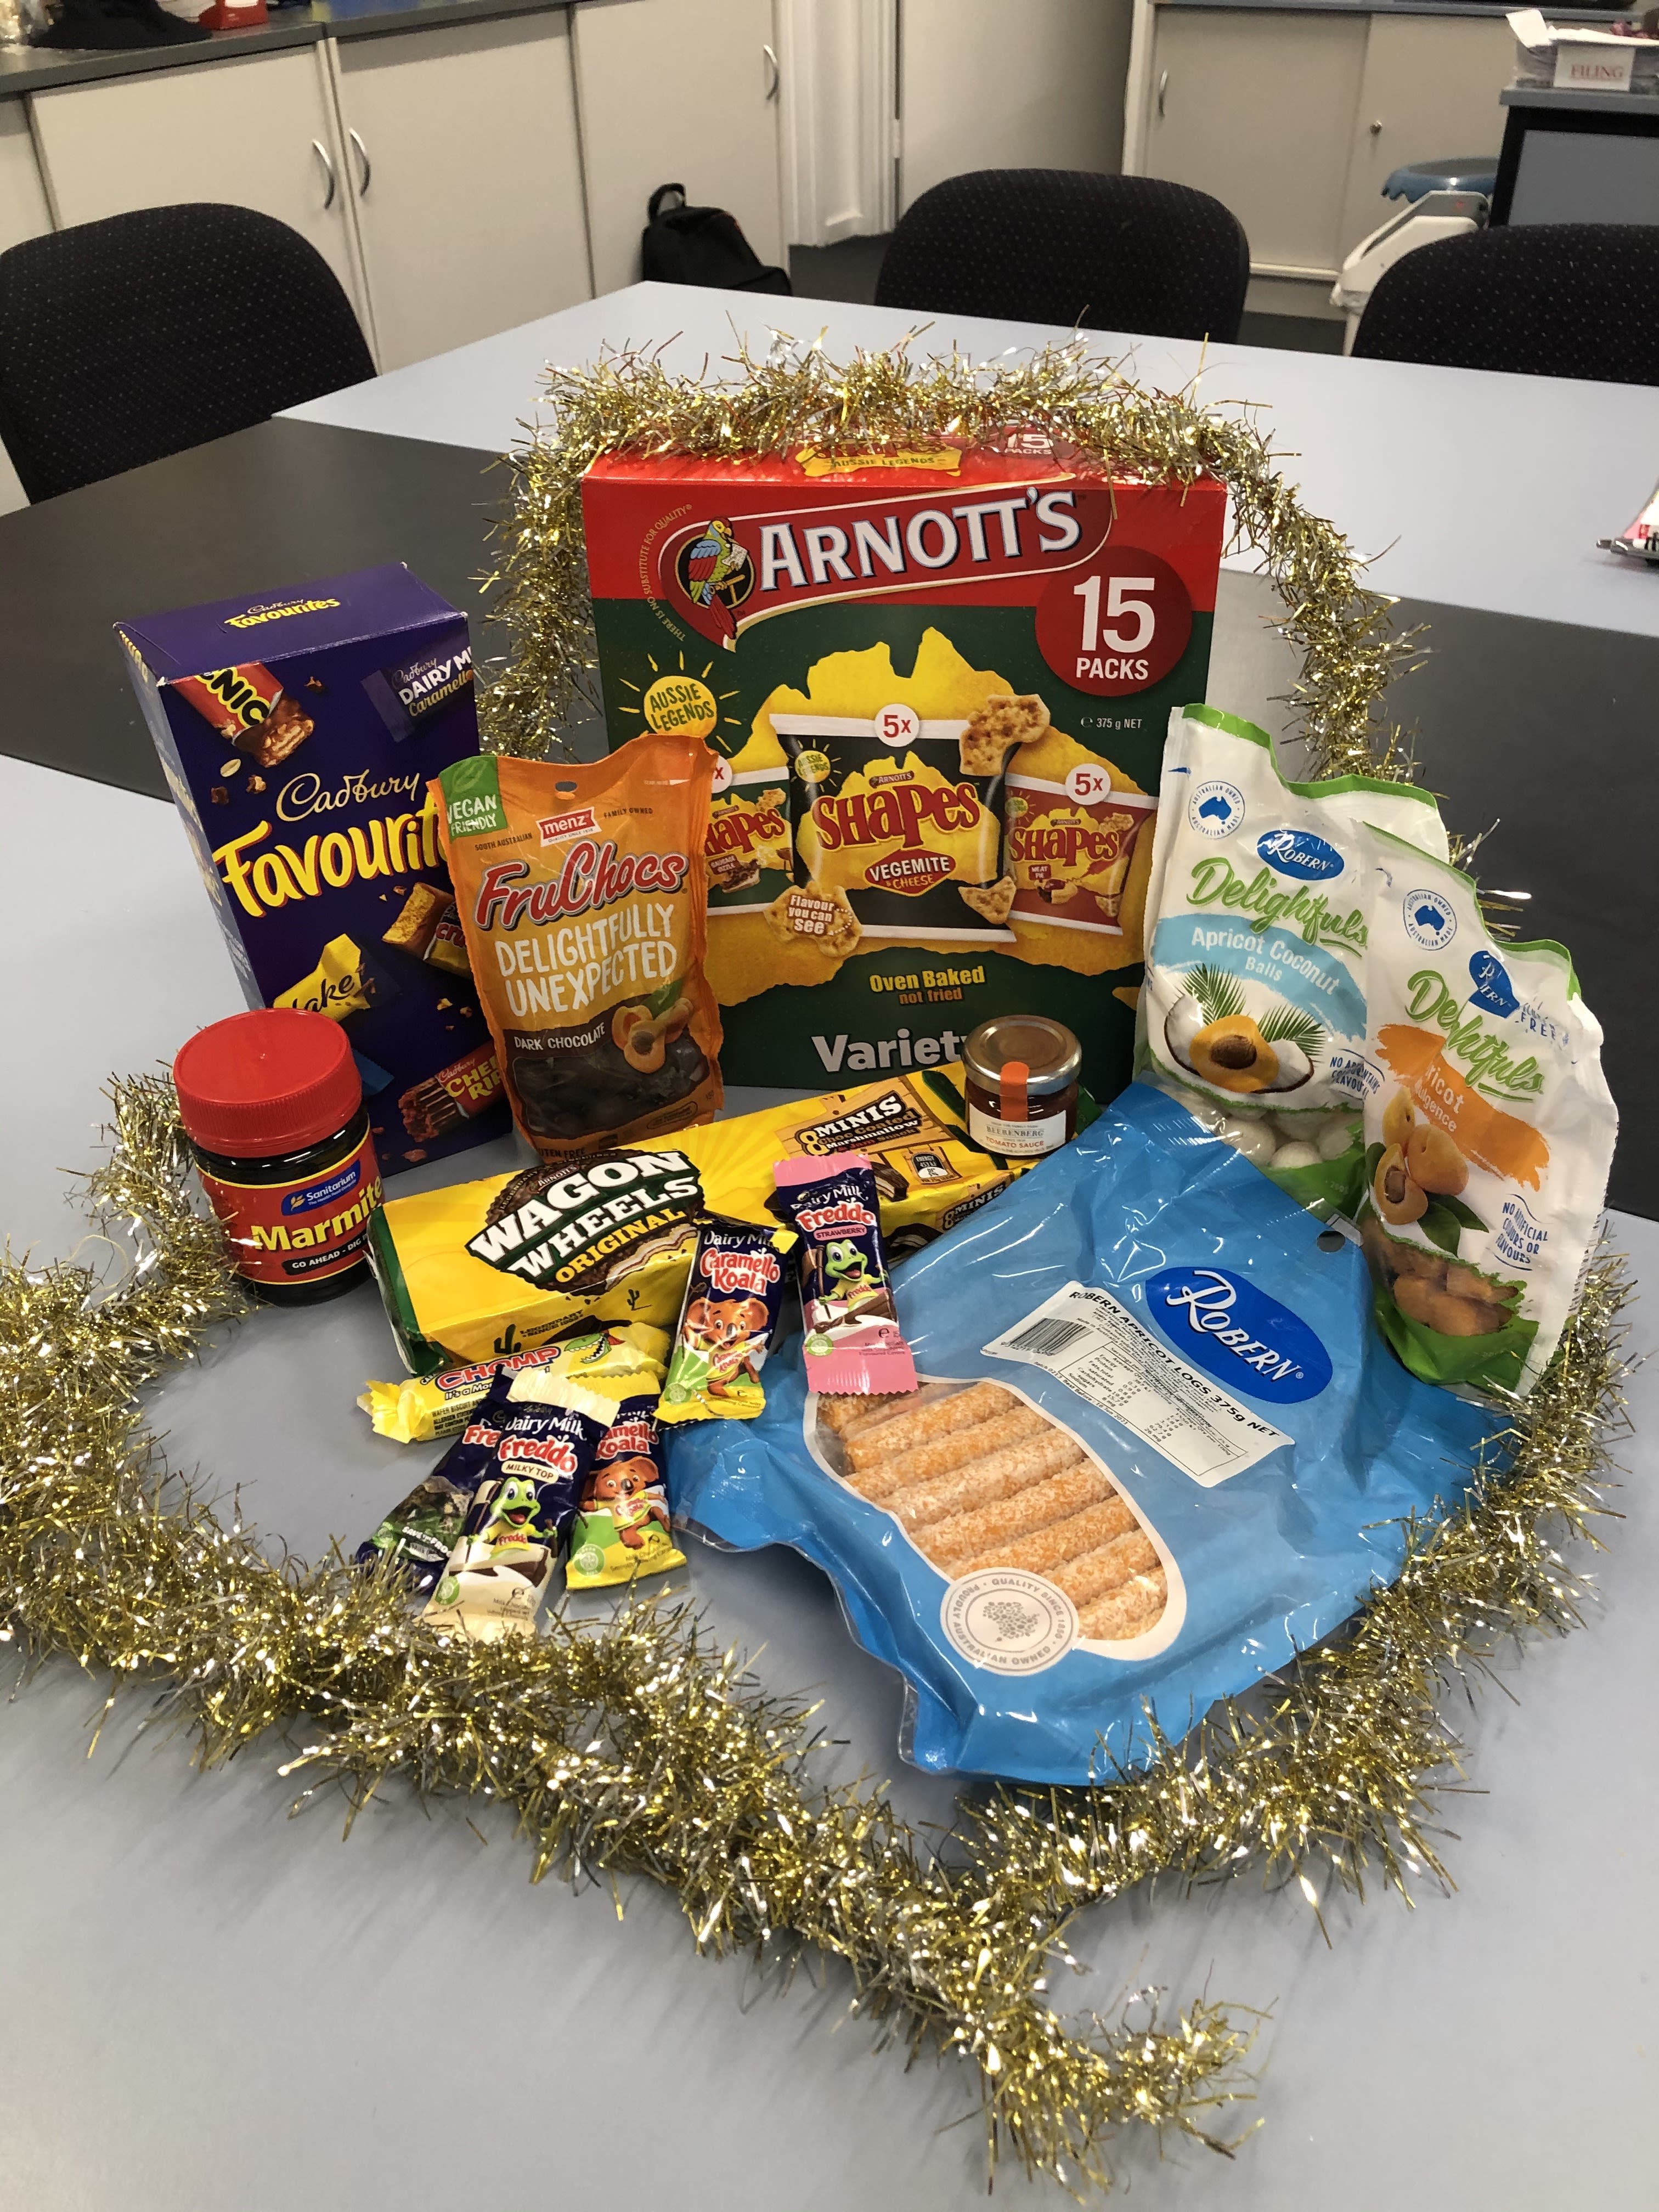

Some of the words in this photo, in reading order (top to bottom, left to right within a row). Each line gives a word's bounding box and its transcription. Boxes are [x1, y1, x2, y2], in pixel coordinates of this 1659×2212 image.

[1571, 65, 1623, 78] FILING
[1008, 433, 1053, 449] 15
[834, 459, 874, 467] AUSSIE
[882, 457, 934, 466] LEGENDS
[644, 528, 658, 545] FOR
[760, 486, 1082, 591] ARNOTT'S
[639, 545, 653, 595] SUBSTITUTE
[224, 596, 341, 629] Favourites
[246, 598, 304, 615] Cadbury
[647, 596, 659, 611] NO
[655, 610, 665, 619] IS
[1074, 575, 1155, 653] 15
[662, 618, 686, 641] THERE
[391, 658, 437, 689] Cadbury
[1076, 658, 1149, 680] PACKS
[398, 659, 452, 705] DAIRY
[650, 684, 701, 713] AUSSIE
[651, 701, 714, 731] LEGENDS
[882, 714, 911, 738] 5x
[1096, 717, 1113, 729] 375
[1124, 718, 1143, 730] NET
[276, 769, 420, 822] Cadbury
[1075, 772, 1103, 795] 5x
[1192, 785, 1223, 804] AUSTRALIAN
[1225, 788, 1240, 804] OWNED
[447, 794, 497, 823] VEGAN
[603, 809, 627, 819] FAMILY
[450, 813, 498, 836] FRIENDLY
[544, 814, 588, 835] menz
[1192, 817, 1225, 836] AUSTRALIAN
[1227, 815, 1239, 830] MADE
[475, 840, 496, 851] SOUTH
[497, 832, 532, 847] AUSTRALIAN
[869, 857, 951, 882] VEGEMITE
[893, 874, 934, 889] CHEESE
[474, 840, 687, 929] FruChocs
[790, 895, 834, 911] Flavour
[1186, 857, 1368, 947] Delightfuls
[1434, 898, 1451, 916] OWNED
[788, 907, 809, 918] you
[811, 911, 832, 922] can
[794, 918, 825, 934] see
[495, 903, 674, 977] DELIGHTFULLY
[1408, 924, 1438, 946] AUSTRALIAN
[1440, 927, 1453, 943] MADE
[1191, 927, 1265, 955] Apricot
[1269, 940, 1340, 996] Coconut
[1245, 957, 1283, 983] Balls
[505, 941, 677, 1018] UNEXPECTED
[869, 973, 919, 992] Oven
[923, 965, 985, 988] Baked
[899, 991, 924, 1004] not
[927, 986, 963, 1002] fried
[514, 1036, 544, 1051] DARK
[548, 1020, 606, 1049] CHOCOLATE
[811, 1028, 964, 1073] Variet
[438, 1058, 476, 1083] Cadbury
[814, 1095, 902, 1137] MINIS
[817, 1131, 853, 1144] Choc
[855, 1110, 917, 1135] Coated
[800, 1131, 830, 1155] 8
[826, 1120, 918, 1149] Marshmallow
[985, 1136, 1017, 1148] TOMATO
[986, 1125, 1044, 1137] BEERENBERG
[850, 1138, 877, 1150] Jam
[306, 1171, 356, 1201] Sanitarium
[499, 1170, 538, 1211] LEGENDARY
[833, 1184, 869, 1201] Milk
[469, 1151, 692, 1262] WAGON
[955, 1183, 1006, 1214] MINIS
[1502, 1202, 1515, 1215] NO
[251, 1176, 382, 1250] Marmite
[797, 1203, 875, 1231] Freddo
[507, 1176, 698, 1278] WHEELS
[816, 1227, 866, 1238] STRAWBERRY
[555, 1207, 687, 1283] ORIGINAL
[704, 1231, 747, 1249] Dairy
[1527, 1242, 1539, 1255] OR
[309, 1251, 340, 1267] AHEAD
[347, 1239, 362, 1251] DIG
[701, 1248, 780, 1283] Caramello
[715, 1269, 766, 1296] Koala
[1166, 1270, 1302, 1381] ROBERN
[1097, 1327, 1119, 1344] Australia
[1119, 1342, 1131, 1353] from
[1069, 1291, 1121, 1314] ROBERN
[1120, 1316, 1176, 1365] APRICOT
[1175, 1367, 1210, 1395] LOGS
[1211, 1396, 1246, 1423] 375g
[1247, 1421, 1280, 1437] NET
[1094, 1356, 1114, 1371] Protein
[1099, 1353, 1118, 1368] Energy
[1110, 1347, 1132, 1365] Servings
[1112, 1357, 1134, 1373] Average
[1068, 1373, 1088, 1389] Sodium
[1077, 1367, 1112, 1392] Carbohydrate
[1077, 1374, 1096, 1388] sugars
[1088, 1368, 1115, 1386] saturated
[445, 1390, 460, 1401] It's
[1048, 1368, 1063, 1379] 0213
[1063, 1379, 1074, 1390] Best
[1075, 1388, 1092, 1402] Before
[1104, 1406, 1114, 1416] Jun
[1114, 1414, 1128, 1425] 2021
[432, 1407, 449, 1417] WAFER
[451, 1401, 470, 1413] BISCUIT
[548, 1417, 587, 1441] Milk
[499, 1436, 577, 1473] Freddo
[506, 1464, 535, 1473] MILKY
[537, 1468, 554, 1479] TOP
[402, 1526, 422, 1539] SAVE
[499, 1532, 527, 1545] Freddo
[953, 1583, 980, 1619] PROUDLY
[992, 1578, 1040, 1593] QUALITY
[1041, 1592, 1064, 1616] SINCE
[953, 1621, 1007, 1663] AUSTRALIAN
[1012, 1645, 1051, 1665] OWNED
